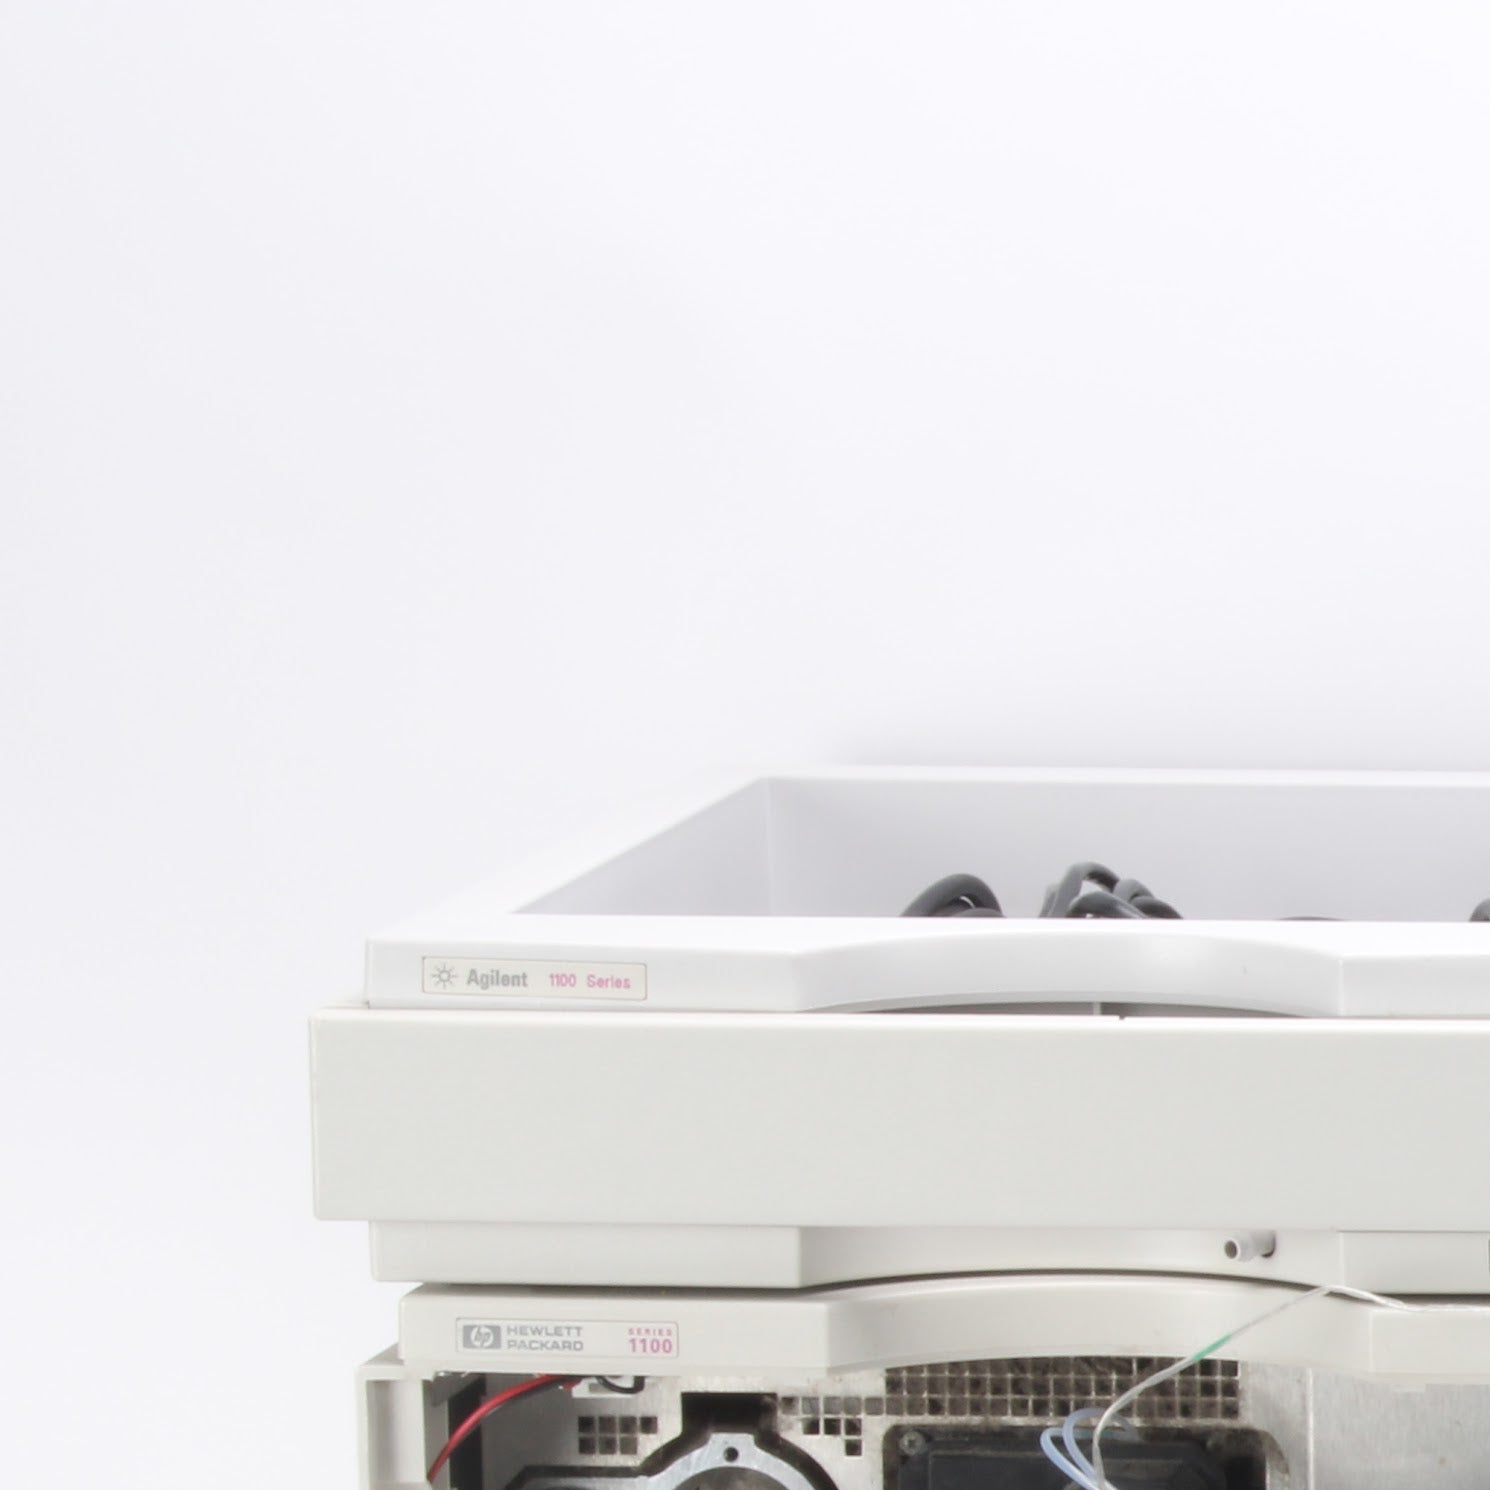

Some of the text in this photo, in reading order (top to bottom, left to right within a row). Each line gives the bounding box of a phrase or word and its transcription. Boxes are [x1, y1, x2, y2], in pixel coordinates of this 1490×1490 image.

[466, 968, 631, 990] Agilent 1100 Series
[506, 1325, 584, 1337] HEWLETT
[628, 1327, 673, 1337] SERIES
[506, 1339, 584, 1351] PACKARD
[628, 1338, 673, 1353] 1100
